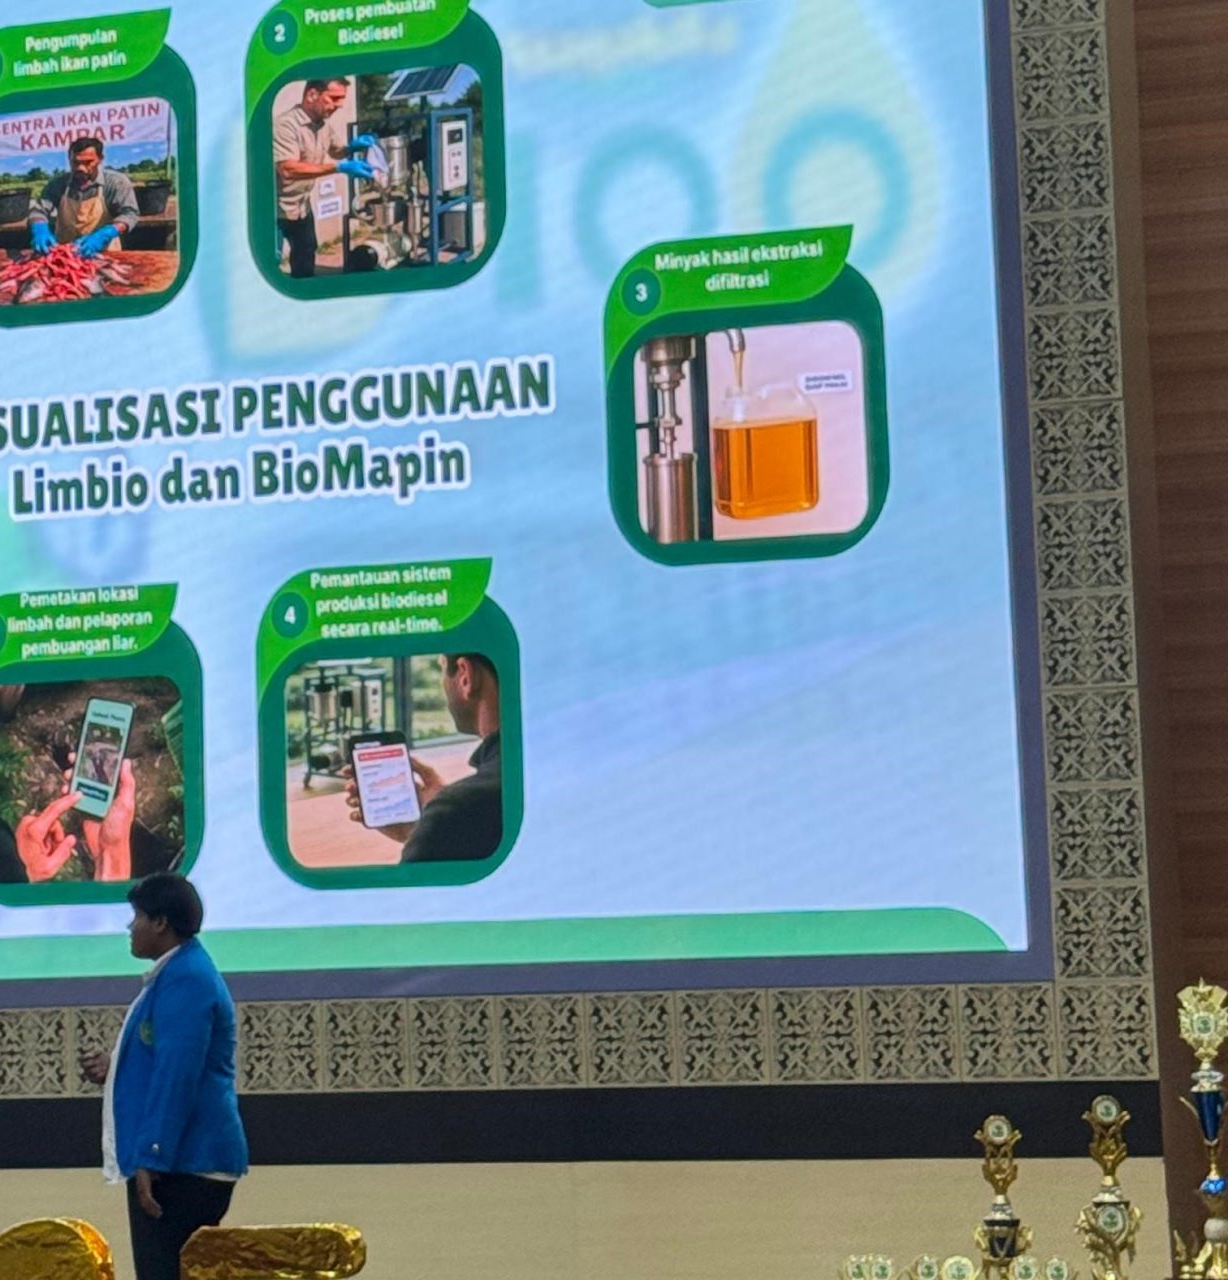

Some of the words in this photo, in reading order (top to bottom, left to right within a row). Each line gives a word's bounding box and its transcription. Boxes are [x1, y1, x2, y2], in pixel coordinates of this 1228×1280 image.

[304, 7, 353, 24] Proses
[25, 29, 117, 53] Pengumpulan
[274, 24, 285, 42] 2
[338, 22, 404, 45] Biodiesel
[13, 59, 59, 77] limbah
[60, 55, 89, 72] ikan
[91, 50, 127, 71] patin
[62, 110, 101, 128] IKAN
[107, 102, 160, 120] PATIN
[654, 251, 710, 272] Minyak
[713, 247, 749, 266] hasil
[751, 239, 823, 262] ekstraksi
[705, 269, 769, 292] difiltrasi
[635, 283, 648, 302] 3
[234, 362, 551, 431] PENGGUNAAN
[13, 465, 148, 514] Limbio
[160, 457, 239, 504] dan
[253, 437, 465, 498] BioMapin
[310, 570, 400, 589] Pemantauan
[403, 566, 452, 582] sistem
[20, 589, 96, 608] Pemetakan
[98, 585, 138, 602] lokasi
[316, 593, 379, 617] produksi
[381, 589, 448, 609] biodiesel
[7, 615, 53, 633] limbah
[55, 614, 80, 630] dan
[83, 611, 153, 631] pelaporan
[284, 606, 296, 624] 4
[321, 622, 371, 638] secara
[373, 615, 443, 634] real-time.
[22, 638, 110, 660] pembuangan
[112, 635, 138, 651] liar.
